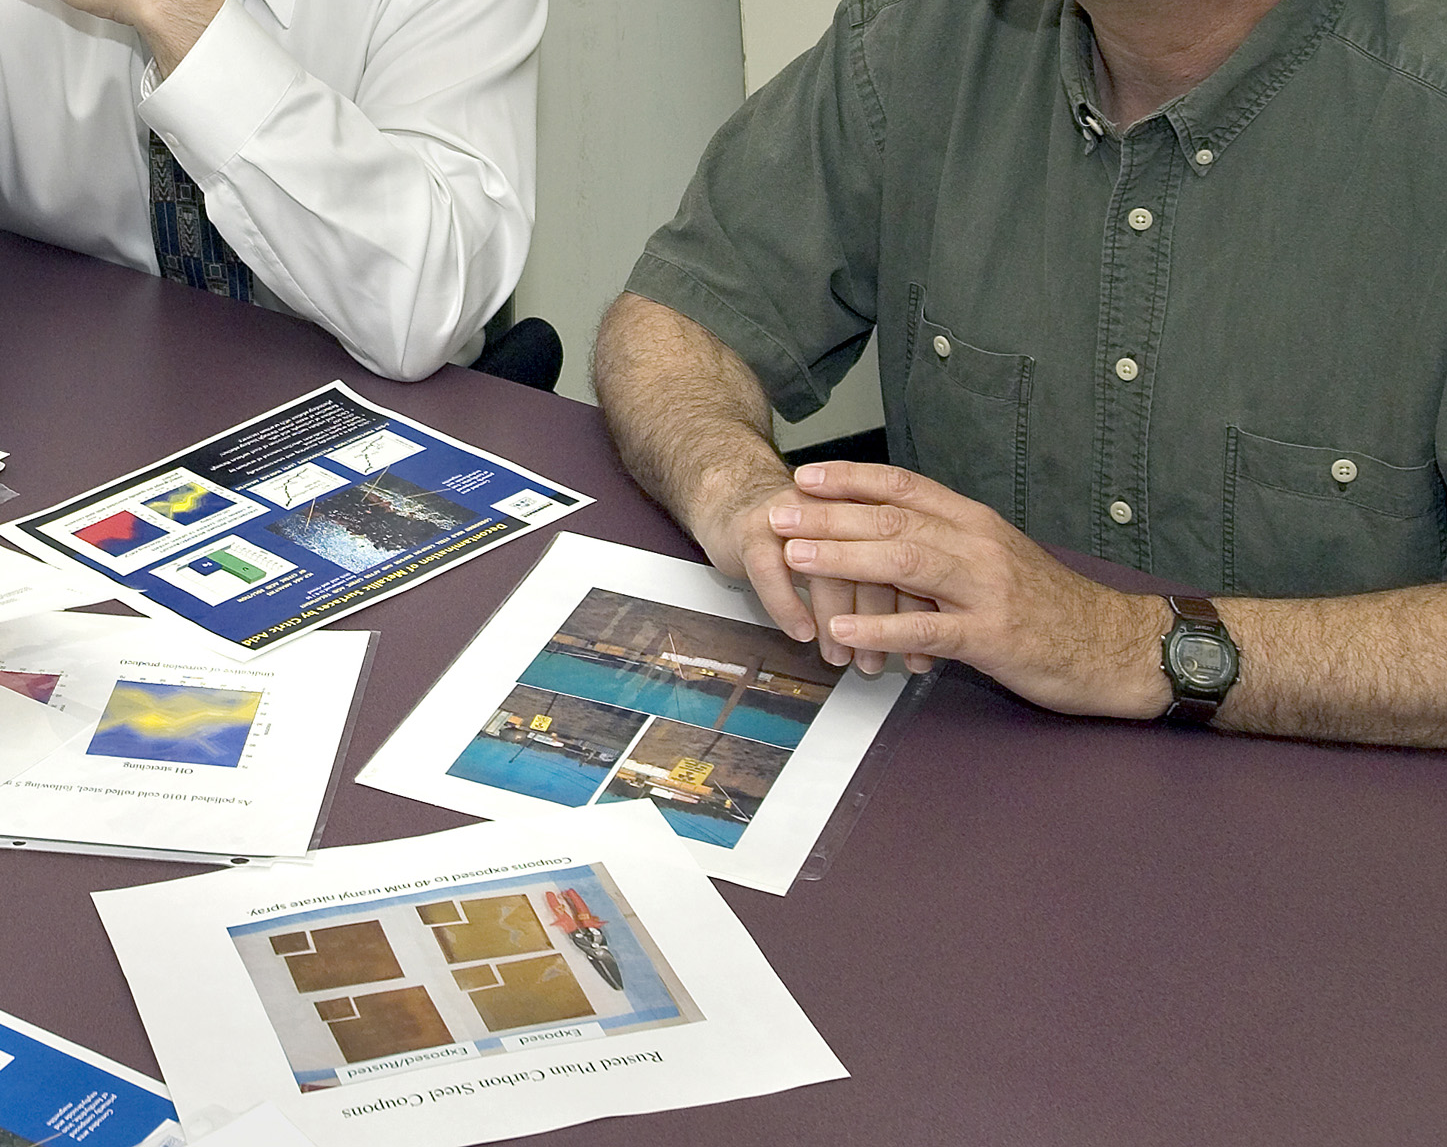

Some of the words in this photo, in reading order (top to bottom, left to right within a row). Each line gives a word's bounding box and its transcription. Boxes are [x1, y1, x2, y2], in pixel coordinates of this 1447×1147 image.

[520, 1030, 581, 1045] Exposed
[346, 1046, 468, 1078] Exposed/Rusted
[552, 1058, 598, 1076] Plain
[600, 1052, 663, 1070] Rusted
[479, 1071, 545, 1087] Carbon
[429, 1085, 474, 1102] Steel
[342, 1094, 423, 1116] Coupons
